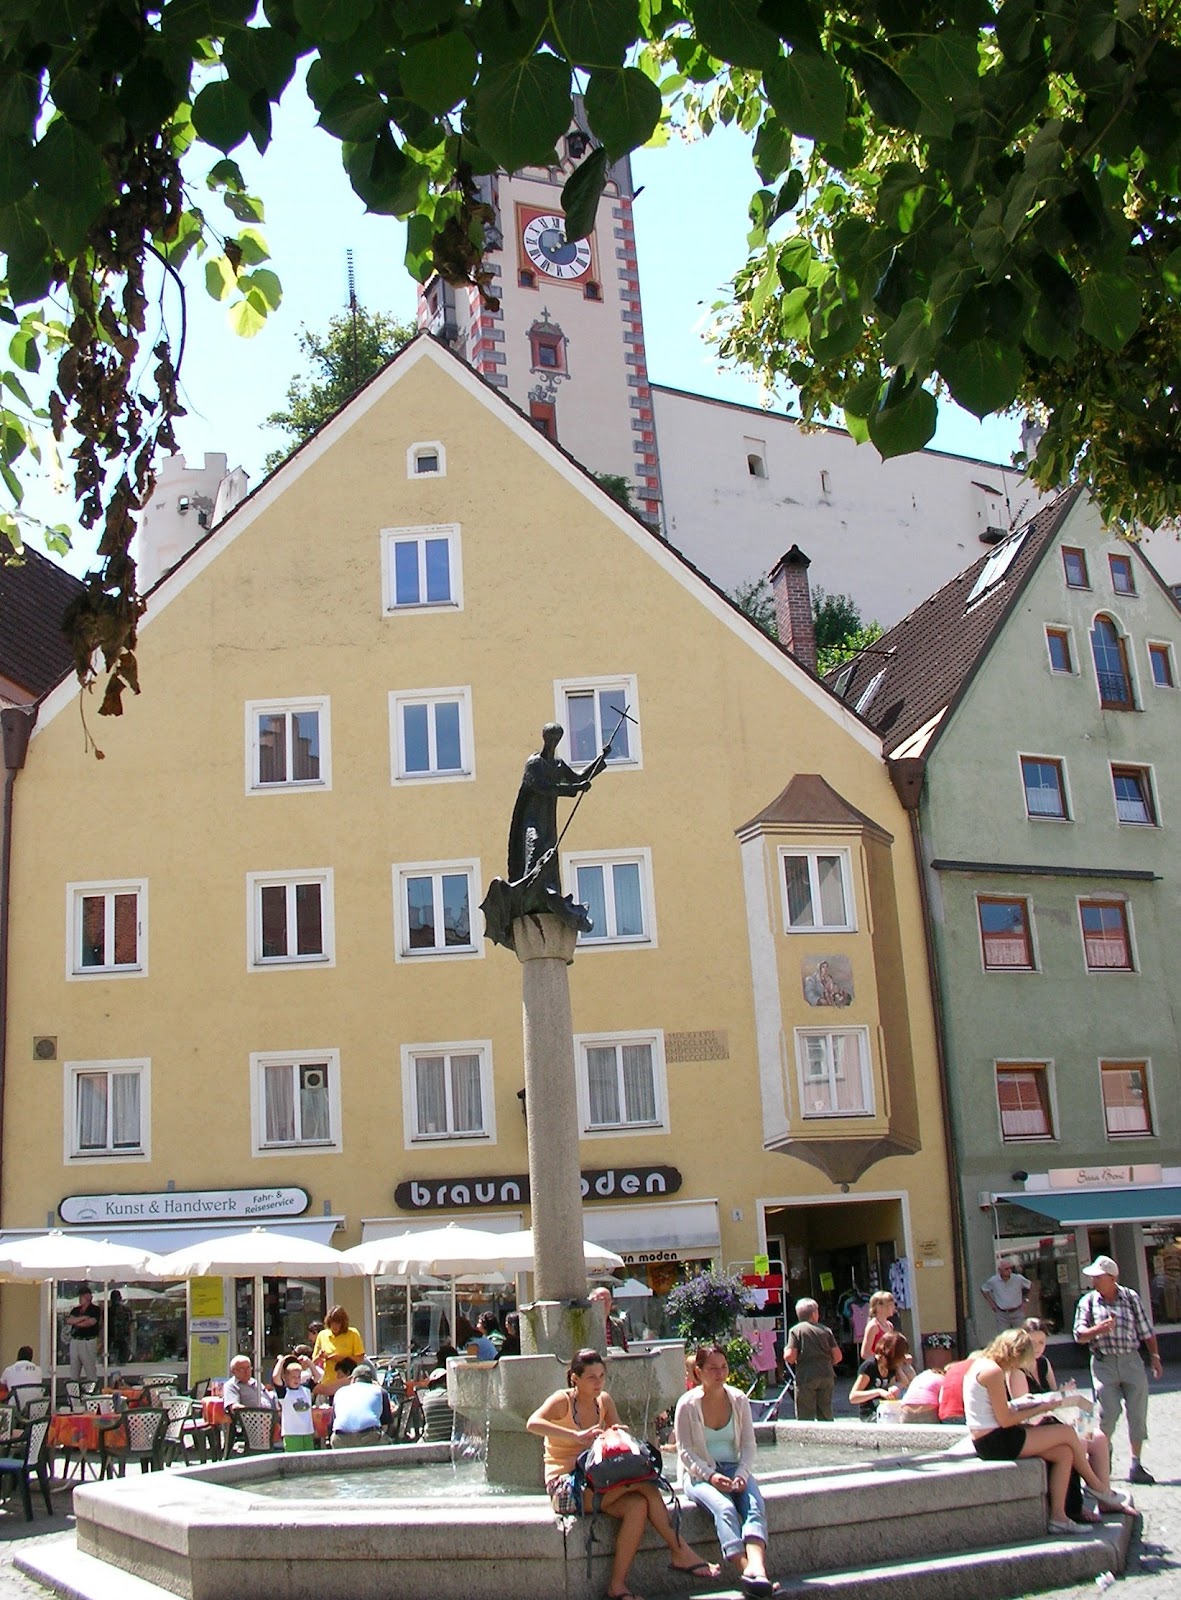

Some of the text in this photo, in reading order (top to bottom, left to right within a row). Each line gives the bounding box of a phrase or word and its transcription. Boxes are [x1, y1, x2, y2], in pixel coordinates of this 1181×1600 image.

[252, 1190, 283, 1204] Fahr- &
[410, 1170, 666, 1207] braun oden
[105, 1198, 238, 1216] Kunst & Handwerk
[244, 1197, 295, 1215] Reiseservice
[639, 1251, 678, 1262] moden
